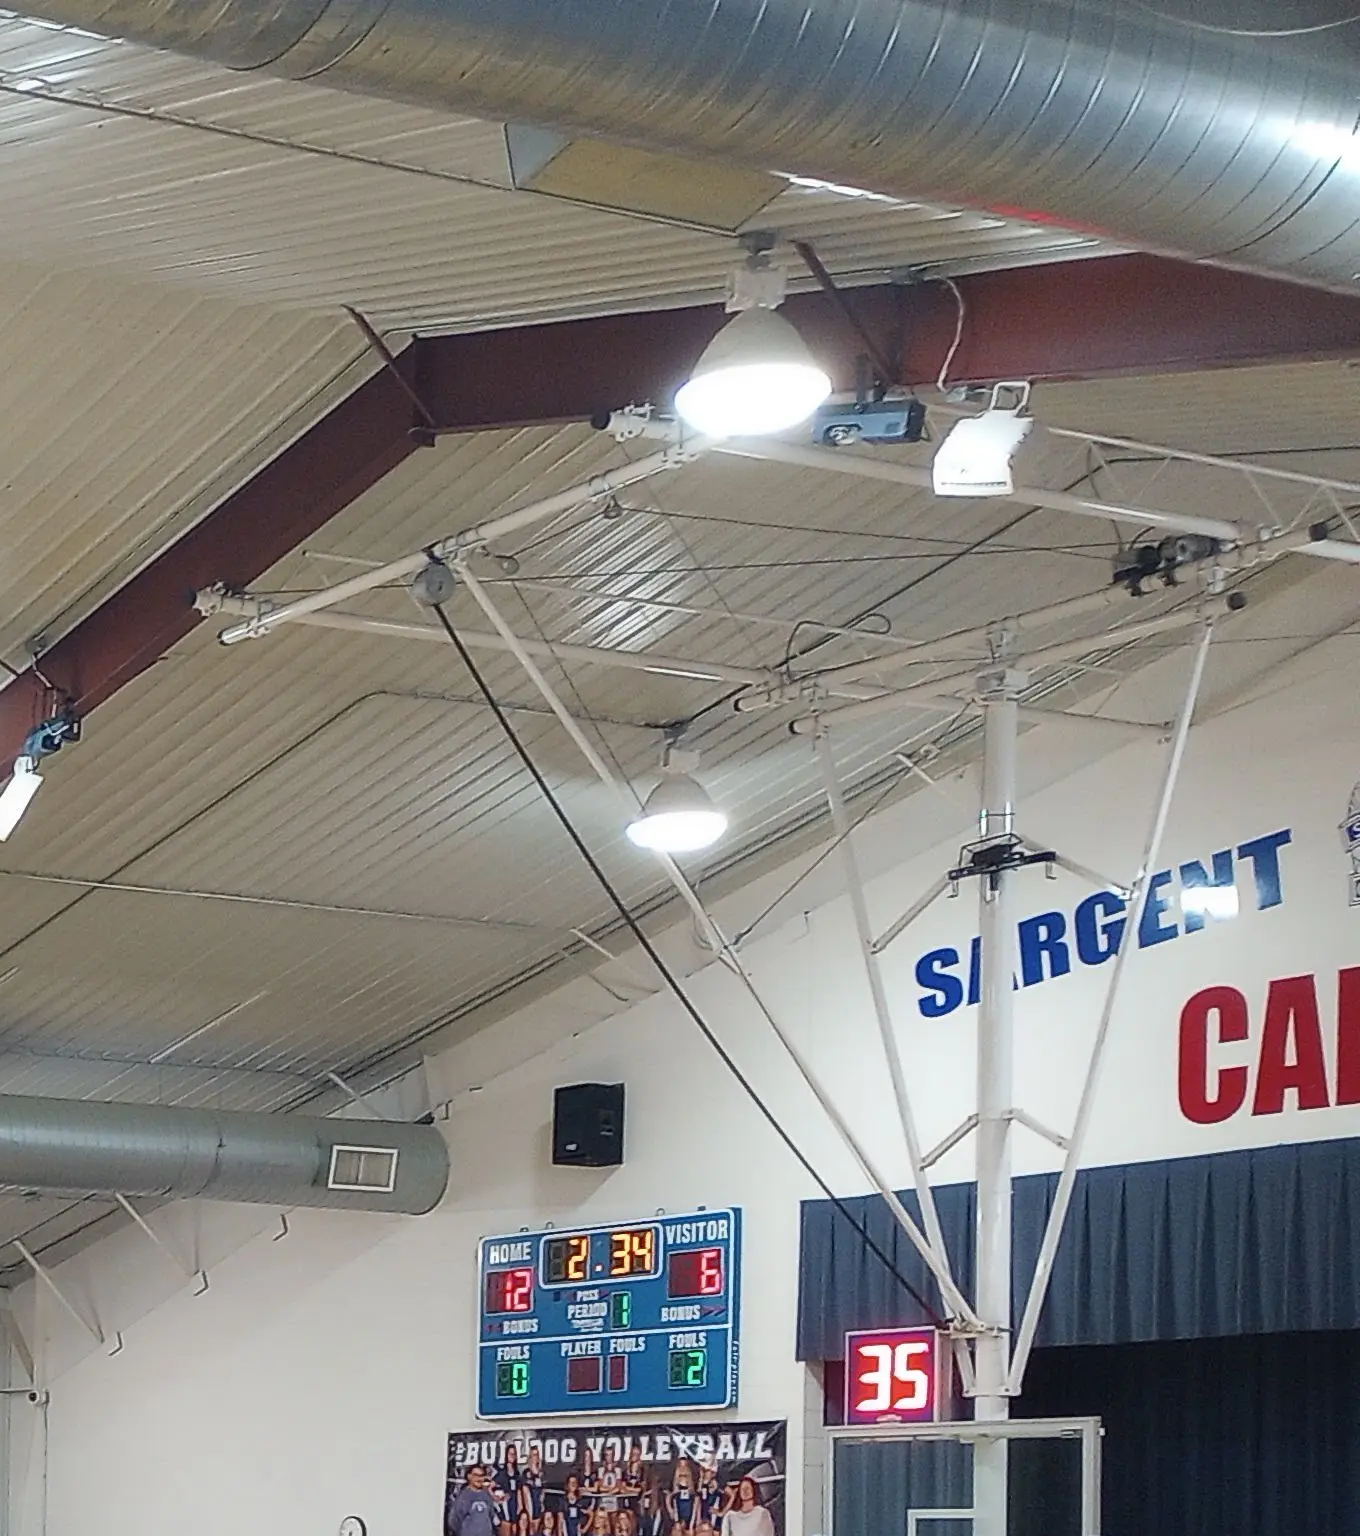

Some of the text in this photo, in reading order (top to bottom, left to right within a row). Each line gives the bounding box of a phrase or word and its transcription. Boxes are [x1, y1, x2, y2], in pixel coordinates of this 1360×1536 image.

[1178, 966, 1360, 1125] CA
[664, 1219, 729, 1245] VISITOR
[489, 1241, 533, 1265] HOME
[700, 1251, 721, 1294] 6
[505, 1271, 531, 1311] 12
[622, 1294, 629, 1326] 1
[496, 1345, 530, 1362] FOULS
[560, 1336, 646, 1357] PLAYER FOULS
[668, 1331, 707, 1349] FOULS
[512, 1363, 528, 1396] 0
[687, 1352, 704, 1385] 2
[855, 1342, 930, 1412] 35
